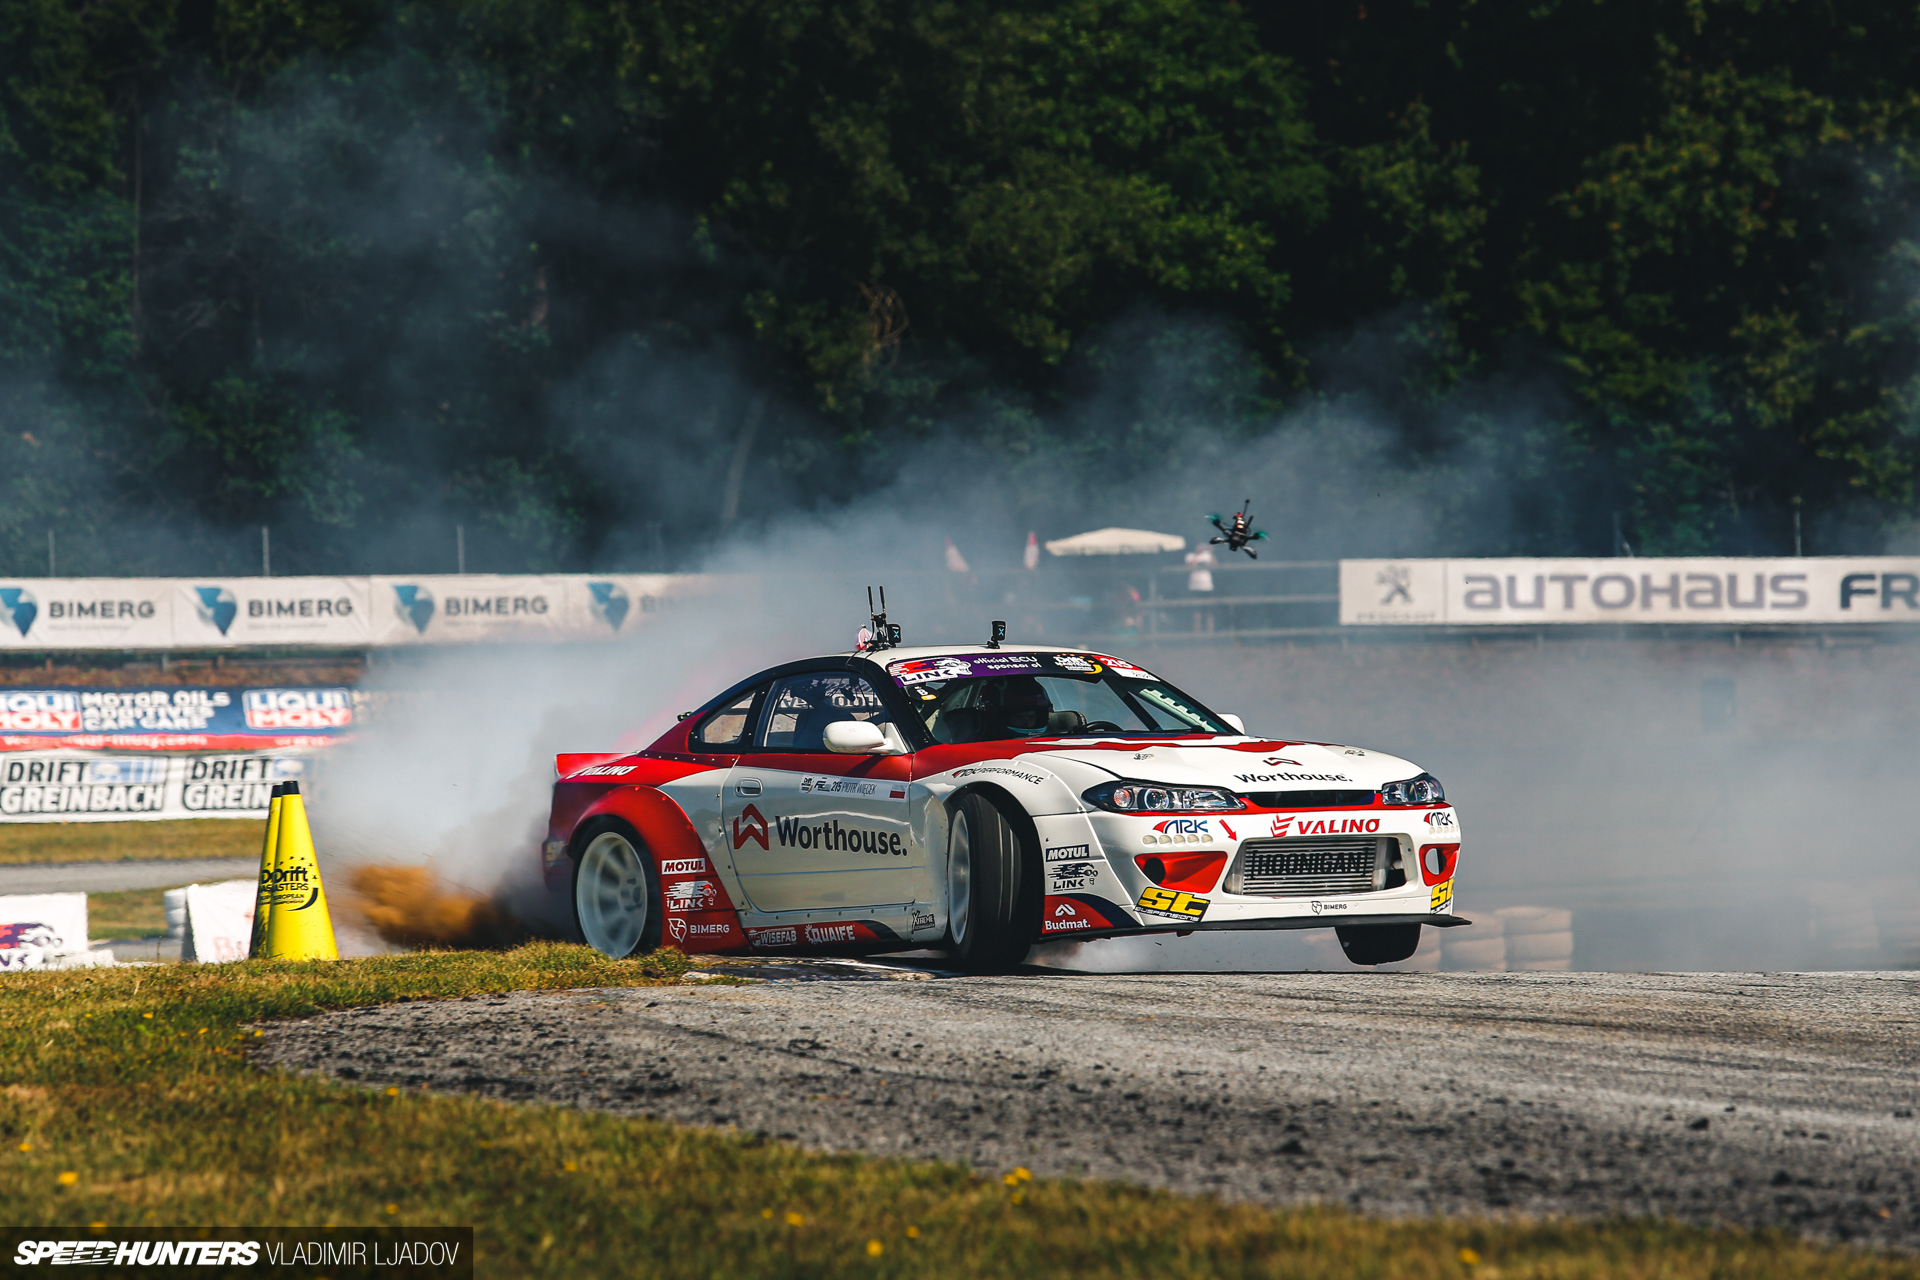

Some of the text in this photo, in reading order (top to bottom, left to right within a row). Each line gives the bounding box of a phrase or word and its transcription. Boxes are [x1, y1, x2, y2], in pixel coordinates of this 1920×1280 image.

[49, 600, 155, 619] BIMERG
[248, 597, 353, 618] BIMERG
[445, 597, 549, 616] BIMERG
[1100, 658, 1133, 669] 215
[901, 670, 952, 682] LINK
[0, 693, 76, 711] IQUI
[80, 690, 231, 707] MOTOR OILS
[251, 691, 343, 710] LIQUI
[253, 710, 343, 727] MOLY
[8, 761, 89, 783] DRIFT
[190, 758, 272, 780] DRIFT
[1233, 772, 1354, 783] Worthouse.
[830, 781, 842, 792] 215
[841, 781, 858, 794] PIOTR
[0, 785, 164, 814] GREINBACH
[183, 782, 271, 811] GREIN
[1164, 819, 1209, 834] ARK
[1298, 818, 1381, 835] VALINO
[1431, 812, 1454, 826] ARK
[775, 814, 908, 856] Worthouse.
[1047, 845, 1089, 861] MOTUL
[274, 866, 309, 883] Drift
[663, 860, 704, 873] MOTUL
[1053, 878, 1085, 890] LINK
[670, 898, 705, 910] LINK
[1323, 903, 1348, 911] BIMERG
[690, 924, 730, 934] BIMERG
[760, 930, 797, 945] WISEFAB
[805, 924, 856, 944] QUAIFE
